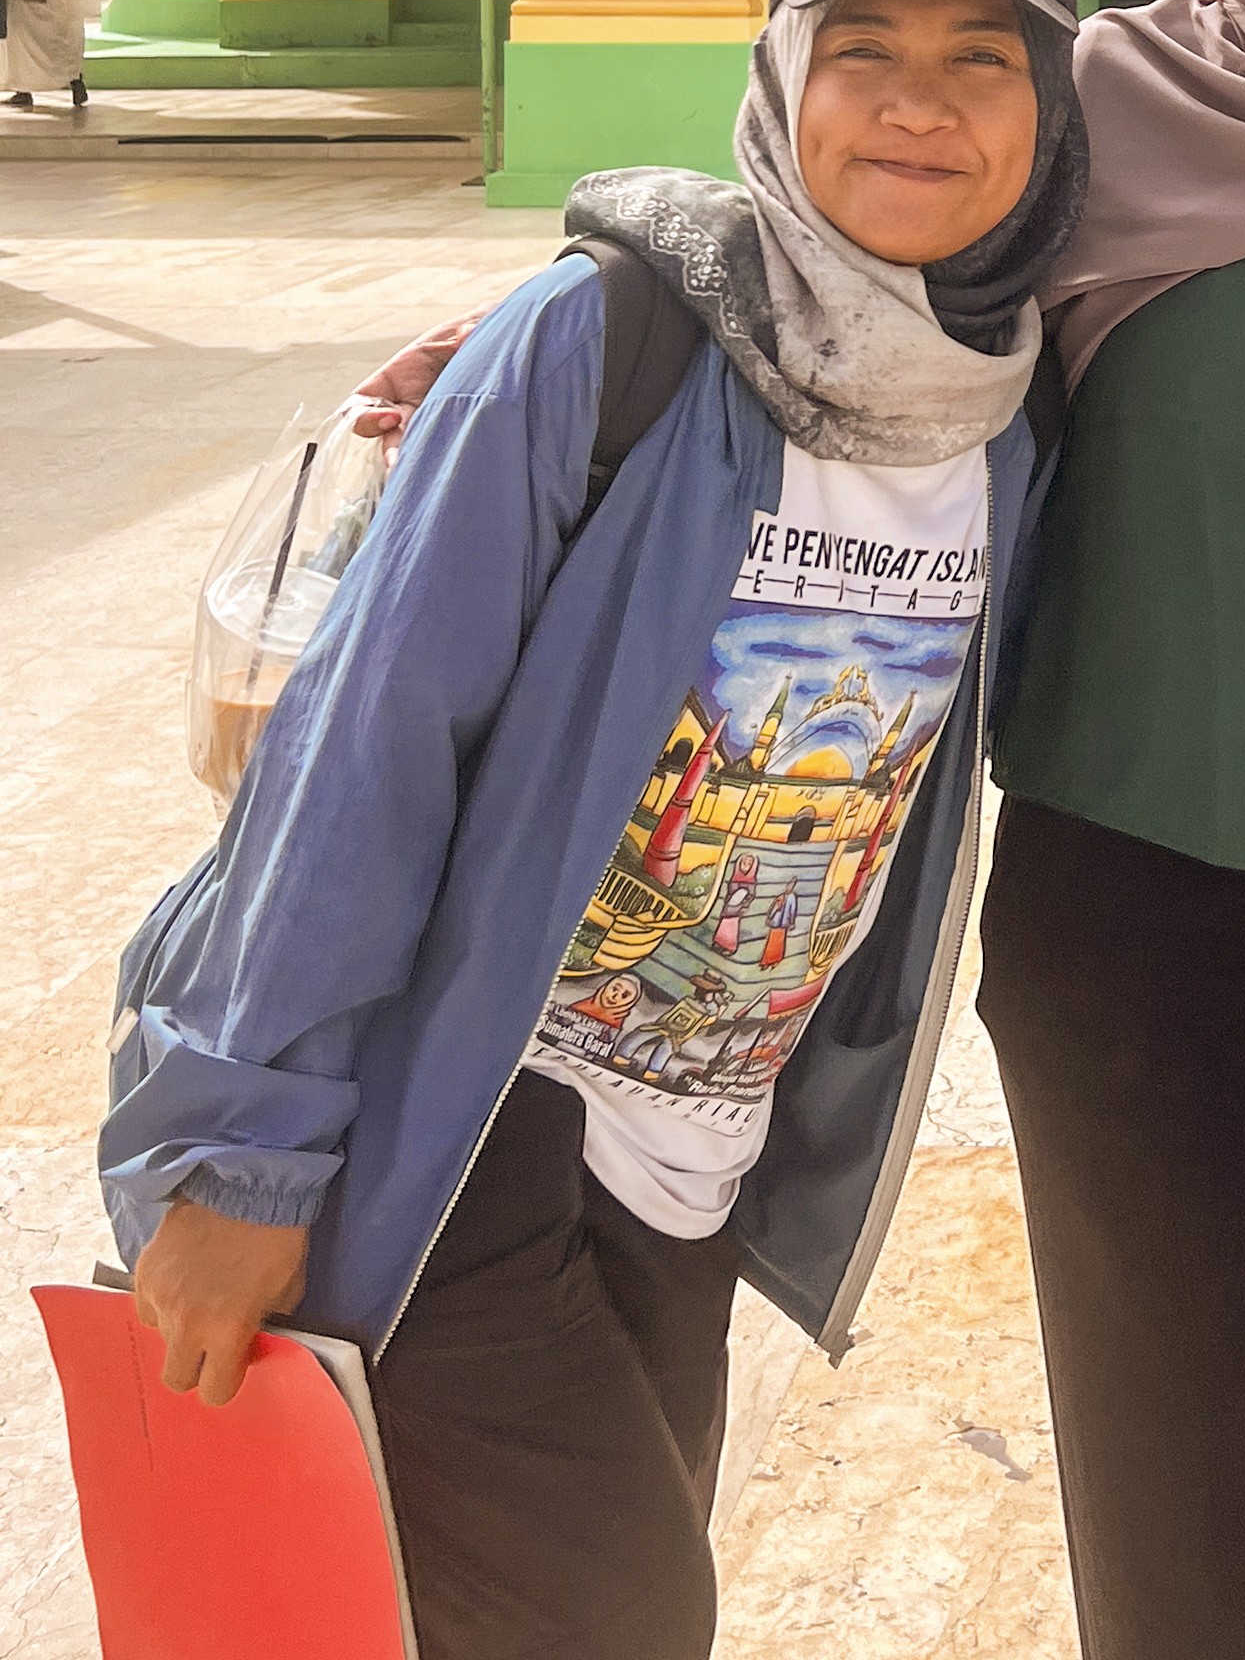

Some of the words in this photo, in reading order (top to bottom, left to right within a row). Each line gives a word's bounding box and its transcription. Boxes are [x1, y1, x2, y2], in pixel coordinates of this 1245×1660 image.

[783, 527, 929, 581] PENYENGAT
[584, 1032, 614, 1058] Barat
[692, 1099, 756, 1123] RIAU
